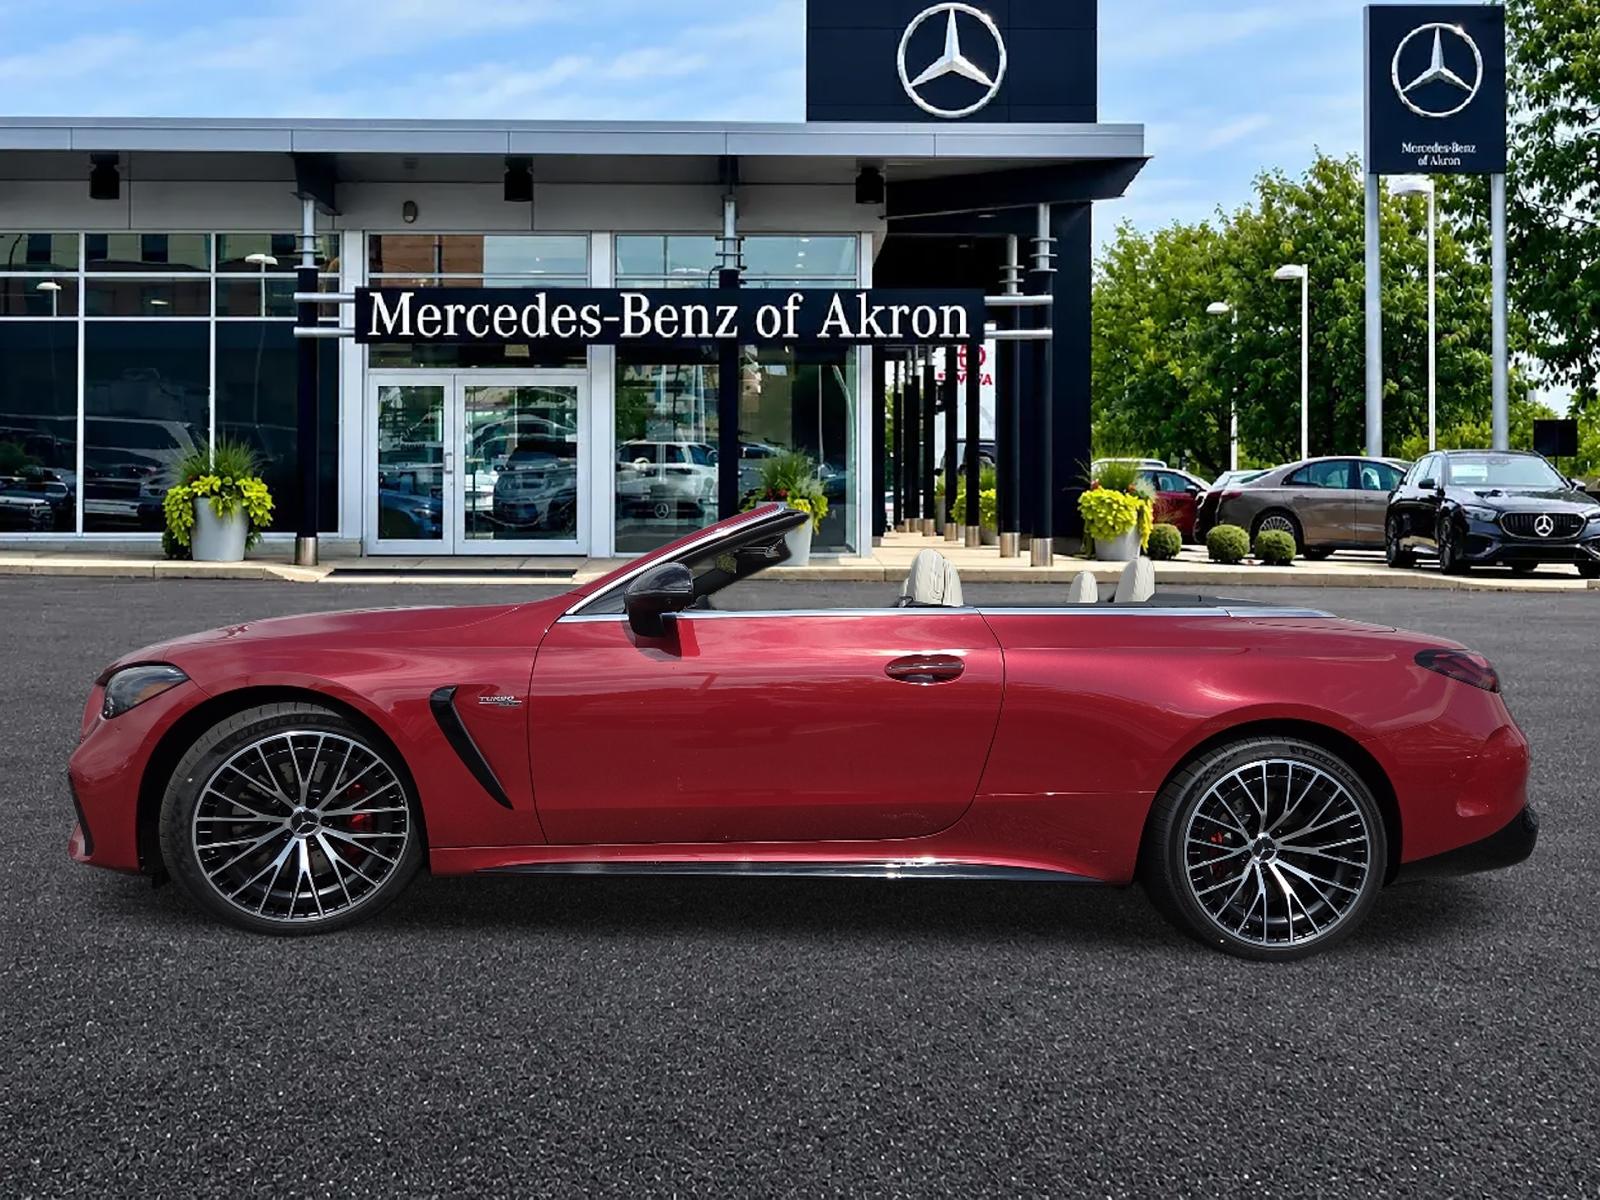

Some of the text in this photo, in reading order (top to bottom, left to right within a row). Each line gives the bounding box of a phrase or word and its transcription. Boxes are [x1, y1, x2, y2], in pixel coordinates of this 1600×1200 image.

[1401, 141, 1477, 154] Mercedes-Benz
[1417, 154, 1461, 166] of Akron
[367, 291, 972, 340] Mercedes-Benz of Akron
[236, 714, 319, 741] MICHELIN
